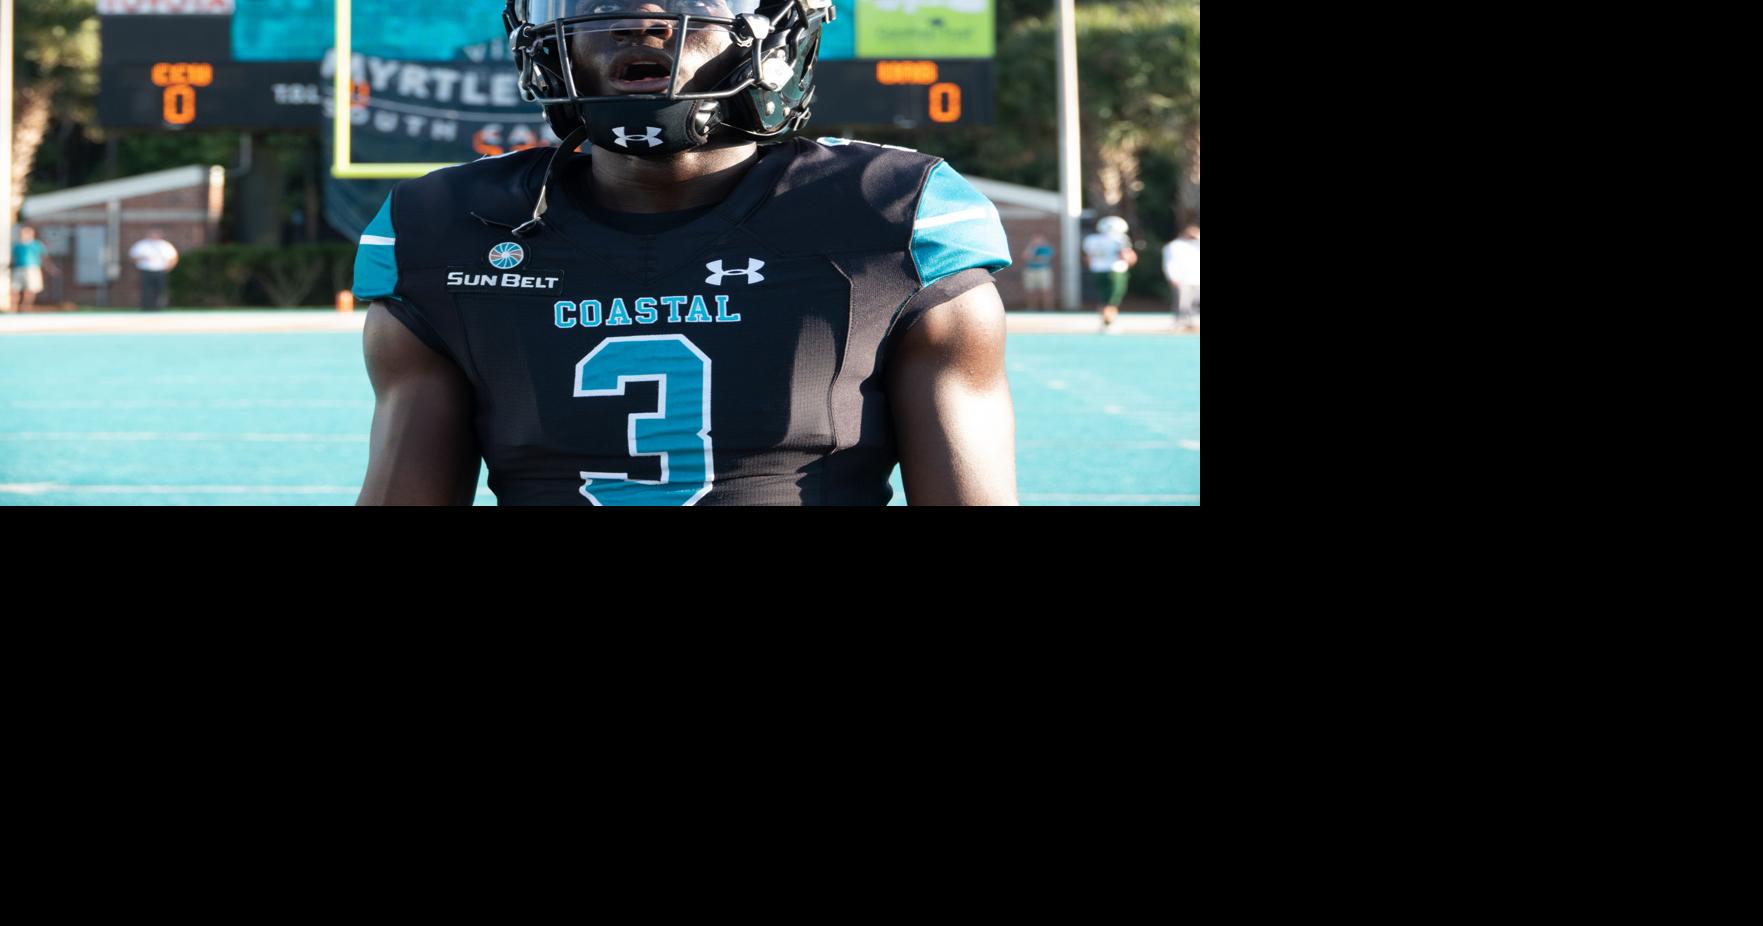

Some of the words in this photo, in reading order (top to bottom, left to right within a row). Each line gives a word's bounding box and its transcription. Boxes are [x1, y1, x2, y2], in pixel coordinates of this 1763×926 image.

[163, 85, 195, 124] 0
[928, 82, 961, 122] 0
[447, 271, 498, 286] SUN
[501, 273, 559, 289] BELT
[554, 295, 741, 329] COASTAL
[573, 333, 714, 507] 3
